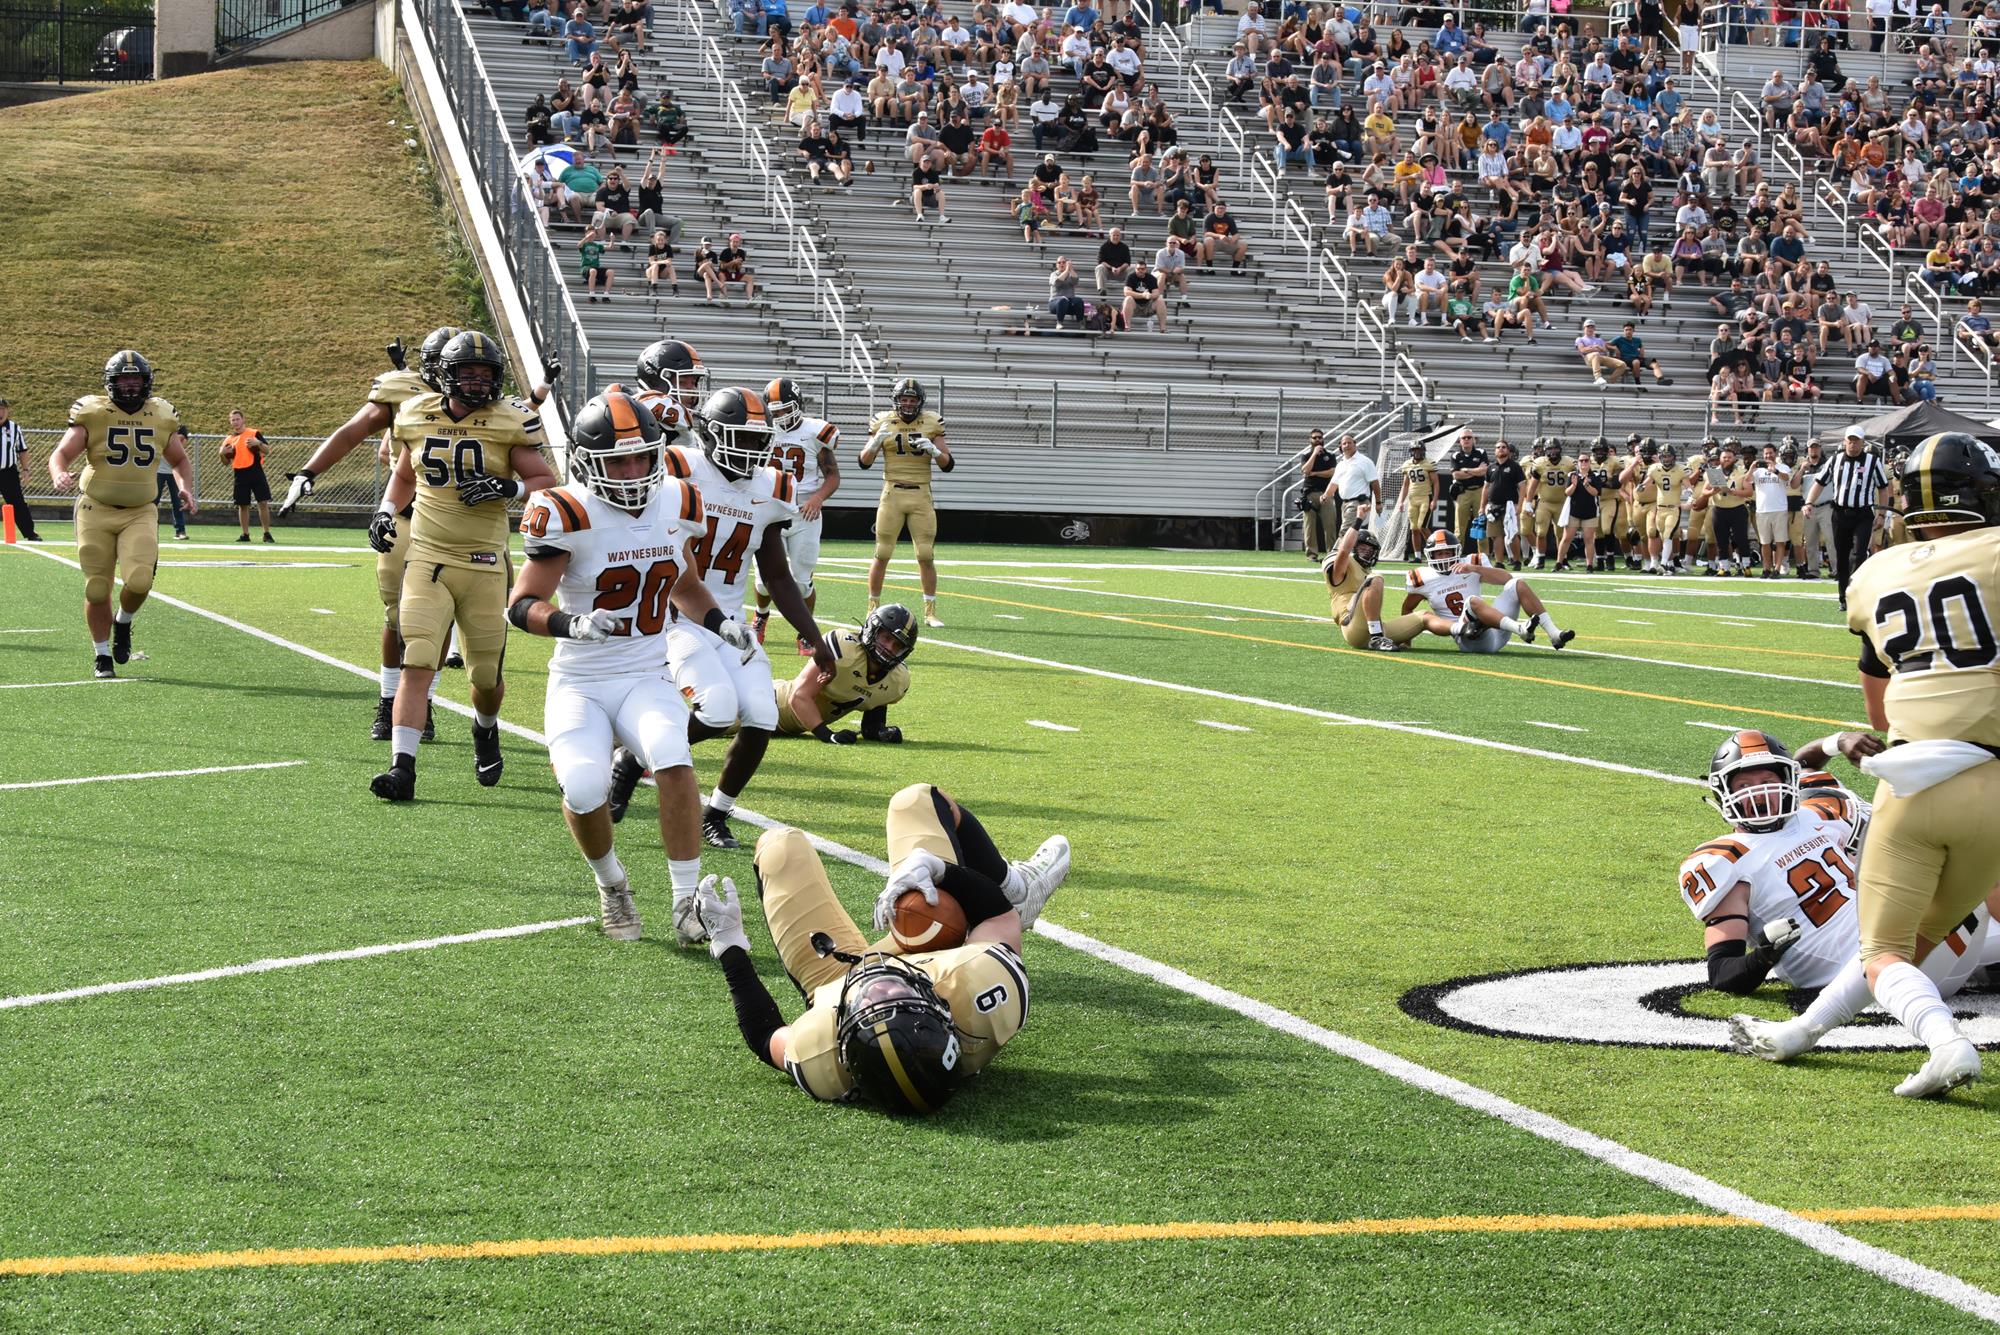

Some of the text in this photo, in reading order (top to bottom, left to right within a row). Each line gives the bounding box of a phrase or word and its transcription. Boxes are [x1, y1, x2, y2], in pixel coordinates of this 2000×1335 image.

[106, 427, 156, 467] 55
[437, 428, 468, 437] GENEVA
[421, 436, 485, 489] 50
[1408, 468, 1426, 483] 85
[1546, 471, 1565, 486] 56
[1662, 477, 1671, 491] 2
[518, 504, 550, 538] 20
[1914, 512, 1950, 522] GENEVA
[607, 545, 675, 563] WAYNESBURG
[690, 514, 755, 586] 44
[592, 558, 680, 638] 20
[1444, 591, 1465, 617] 6
[1874, 571, 2000, 673] 20
[1682, 862, 1717, 907] 21
[1786, 846, 1858, 930] 21
